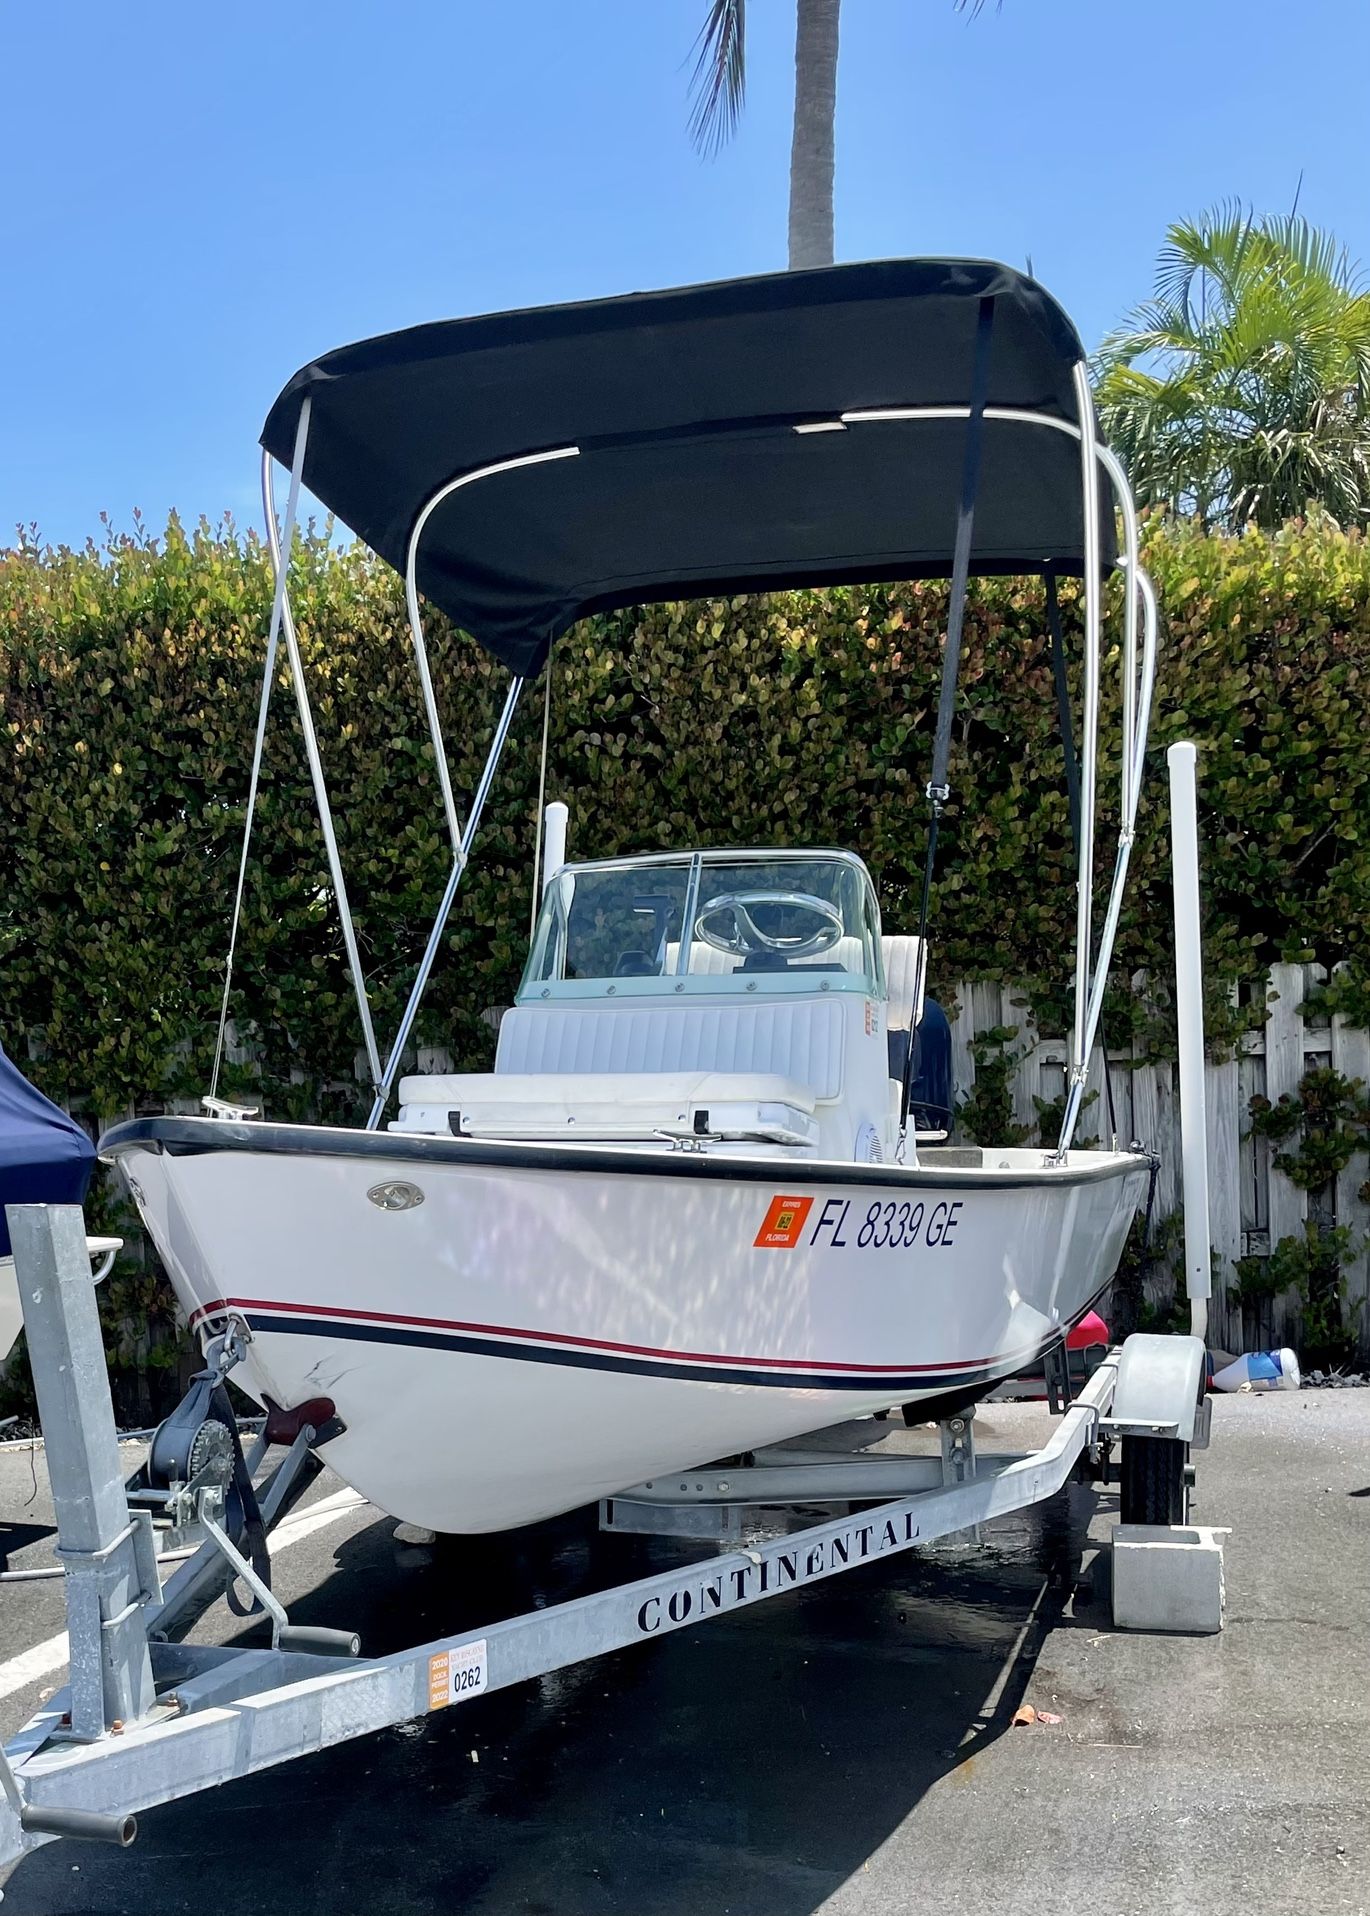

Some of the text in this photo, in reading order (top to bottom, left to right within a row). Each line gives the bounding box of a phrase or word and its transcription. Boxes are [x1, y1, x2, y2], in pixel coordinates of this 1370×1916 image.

[765, 1233, 790, 1242] FLORIDA
[809, 1199, 963, 1248] FL 8339 GE
[637, 1511, 920, 1632] CONTINENTAL
[454, 1666, 481, 1693] 0262
